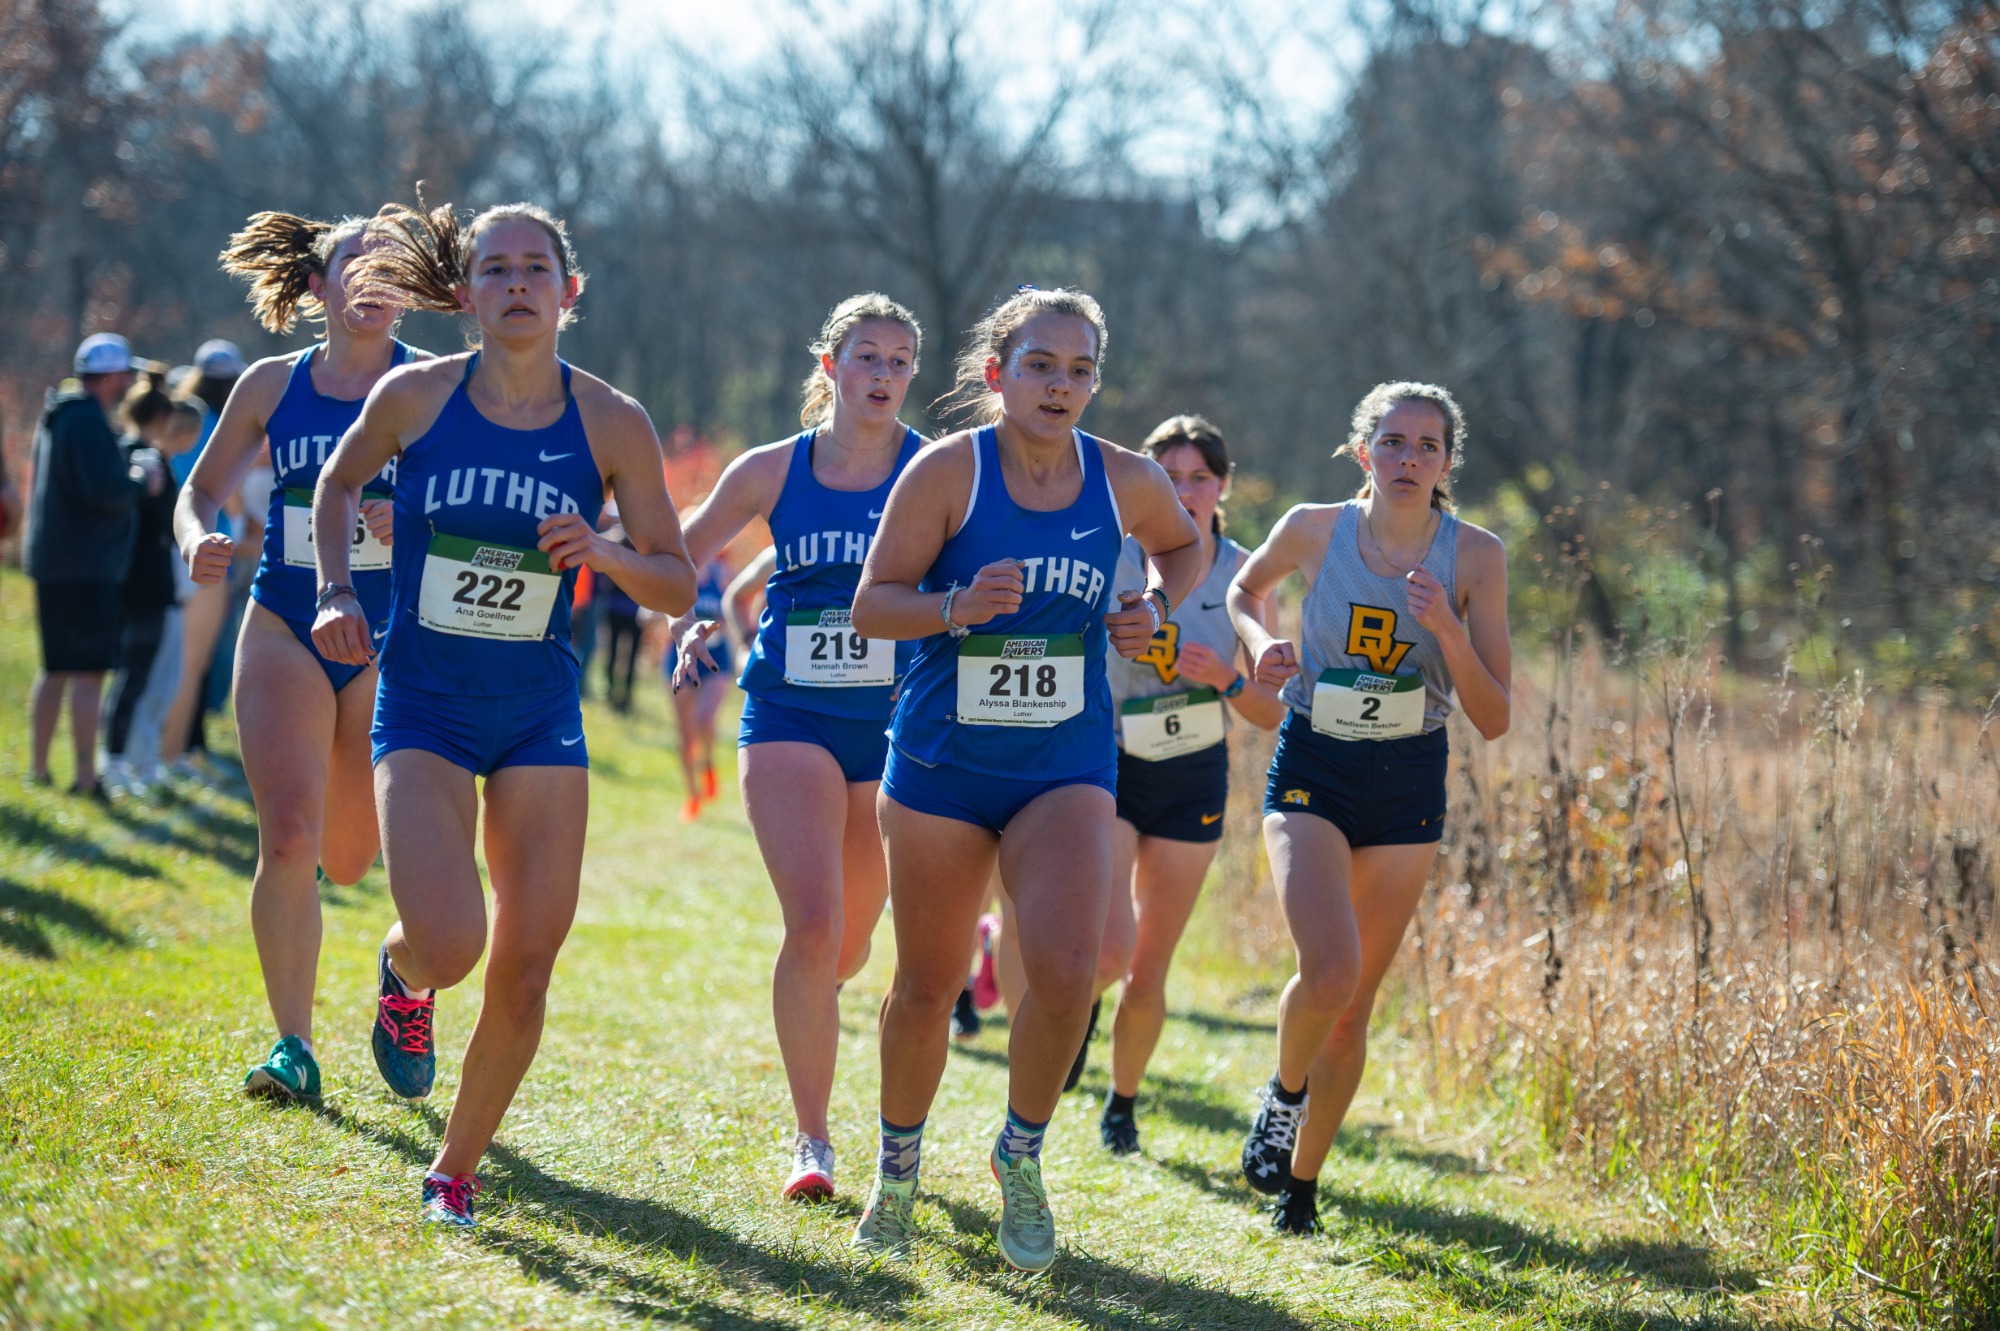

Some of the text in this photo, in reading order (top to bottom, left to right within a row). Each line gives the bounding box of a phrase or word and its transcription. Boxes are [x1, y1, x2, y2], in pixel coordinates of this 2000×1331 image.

[276, 435, 397, 486] LUTR
[478, 547, 521, 561] AMERICAN
[785, 531, 875, 572] LUTH
[1024, 556, 1105, 606] THER
[452, 571, 525, 611] 222
[455, 607, 515, 622] Ana Goellner
[473, 620, 492, 628] Luther
[810, 632, 868, 661] 219
[1005, 640, 1046, 648] AMERICAN
[811, 662, 868, 670] Hannah Brown
[989, 664, 1057, 697] 218
[1359, 675, 1395, 686] AMERICAN
[978, 699, 1067, 709] Alyssa Blankenship
[1360, 697, 1381, 721] 2
[1165, 714, 1181, 736] 6
[1336, 718, 1402, 729] Madisen Betcher
